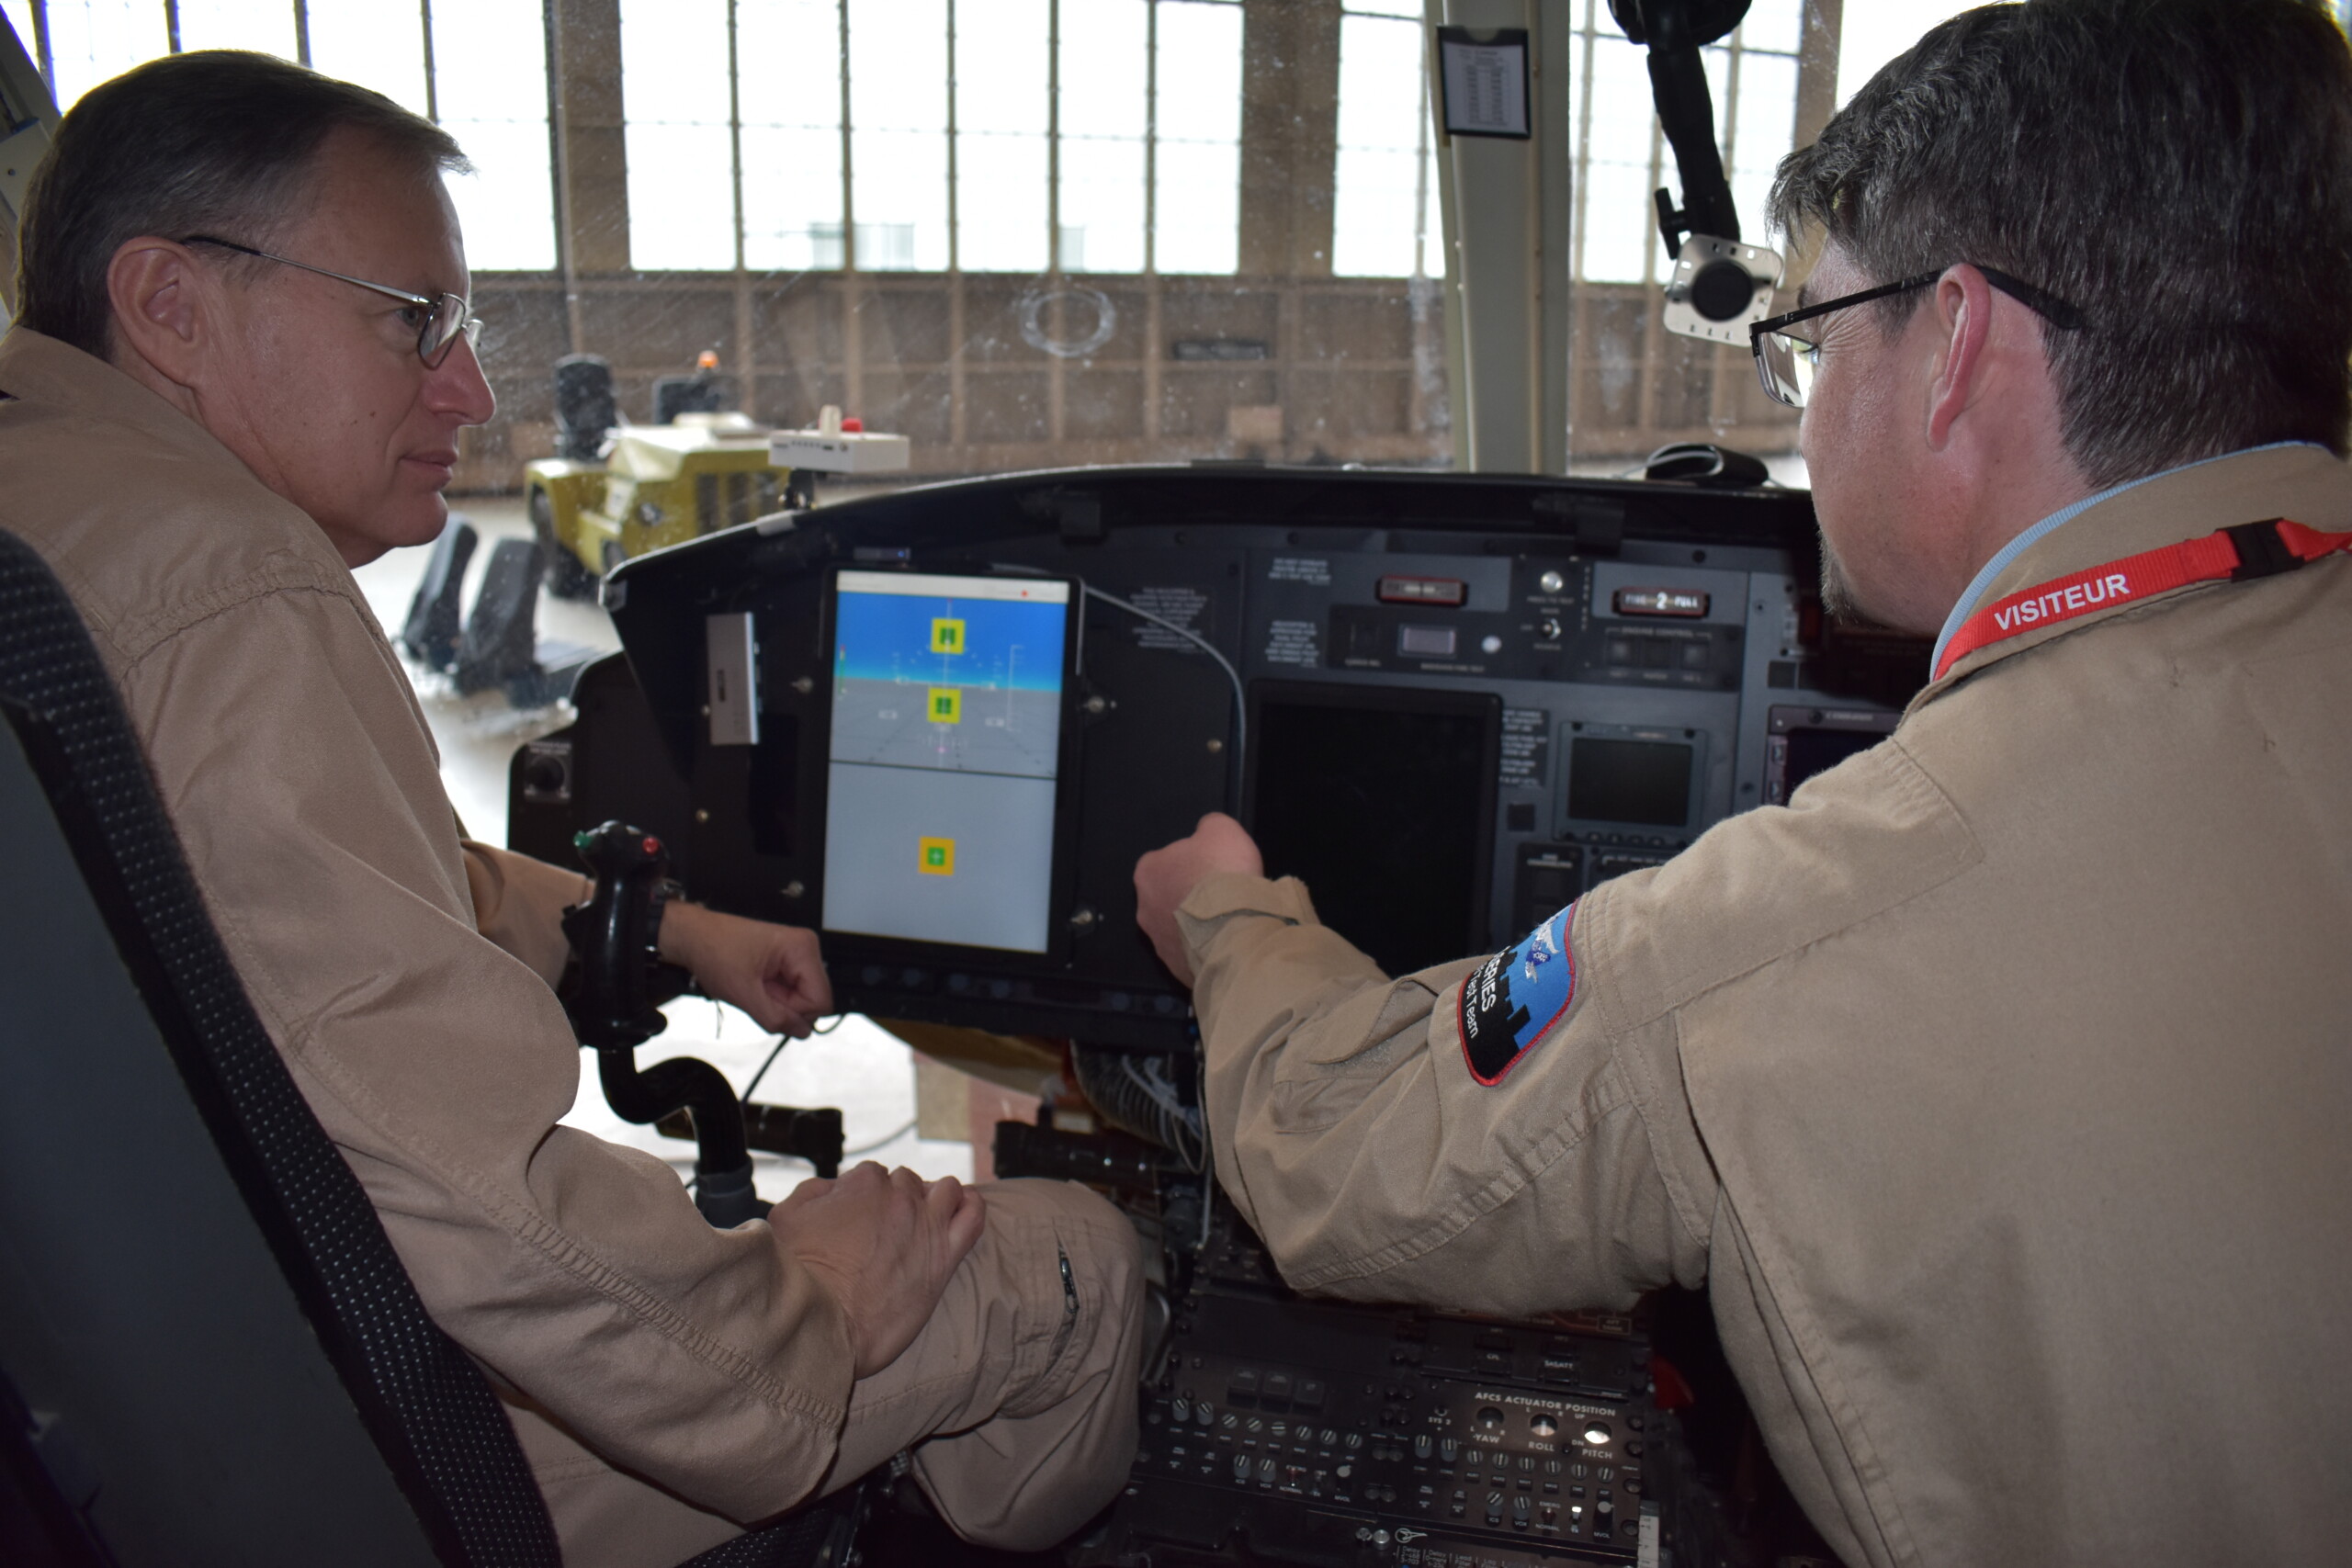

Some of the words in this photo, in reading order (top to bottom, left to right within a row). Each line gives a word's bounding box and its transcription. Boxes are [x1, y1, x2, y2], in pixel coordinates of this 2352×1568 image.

[1657, 591, 1668, 610] 2
[1674, 595, 1698, 608] PULL
[1995, 573, 2131, 630] VISITEUR
[1466, 995, 1479, 1039] Team
[1474, 1392, 1502, 1403] AFCS
[1504, 1395, 1562, 1410] ACTUATOR
[1565, 1402, 1616, 1417] POSITION
[1475, 1434, 1500, 1444] YAW
[1528, 1440, 1555, 1452] ROLL
[1571, 1438, 1584, 1447] DN
[1582, 1448, 1613, 1460] PITCH
